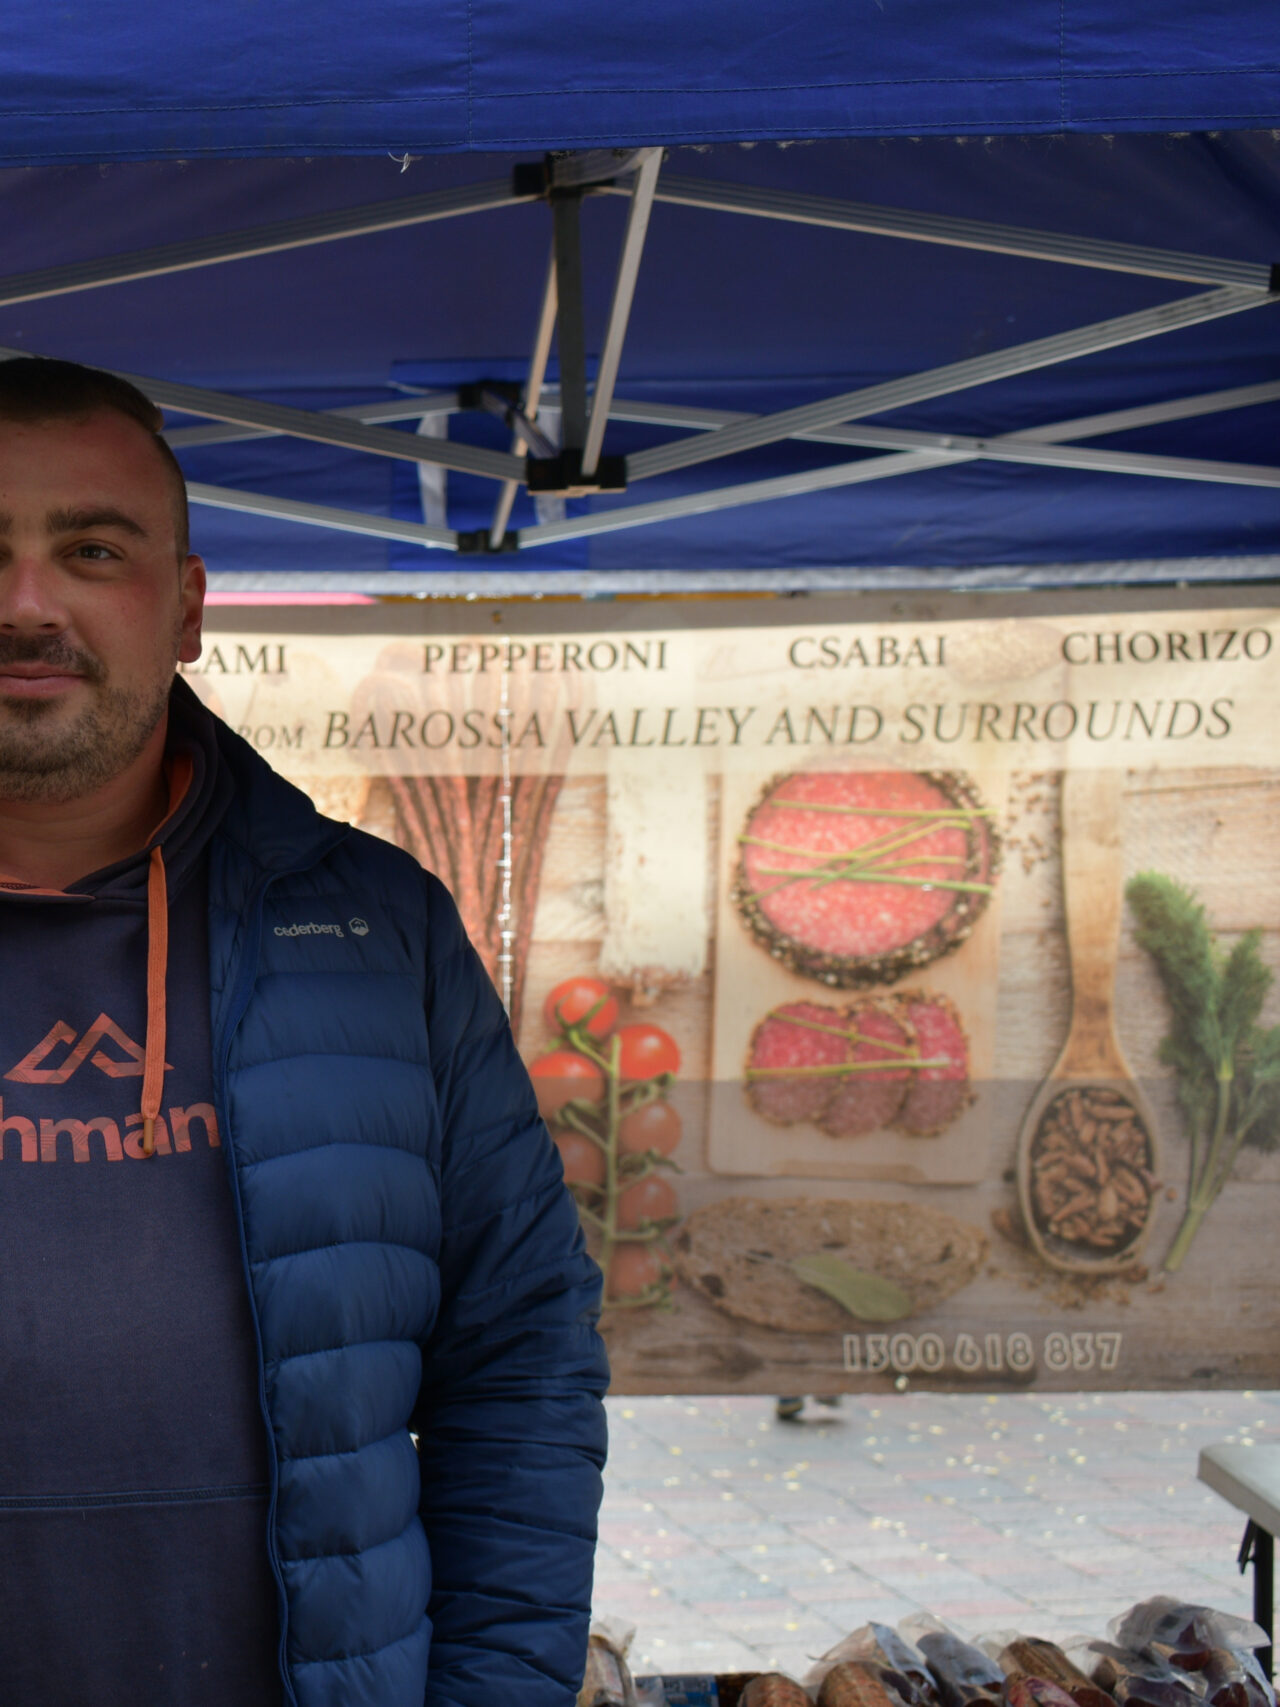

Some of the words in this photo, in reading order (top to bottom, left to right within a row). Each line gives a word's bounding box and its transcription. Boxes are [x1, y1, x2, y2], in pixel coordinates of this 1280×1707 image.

[422, 640, 668, 674] PEPPERONI
[788, 636, 947, 668] CSABAI
[1061, 628, 1272, 664] CHORIZO
[322, 709, 547, 750] BAROSSA
[565, 705, 757, 748] VALLEY
[765, 704, 884, 745] AND
[900, 699, 1235, 744] SURROUNDS
[842, 1331, 945, 1373] 1300
[953, 1332, 1034, 1372] 618
[1044, 1332, 1122, 1373] 837
